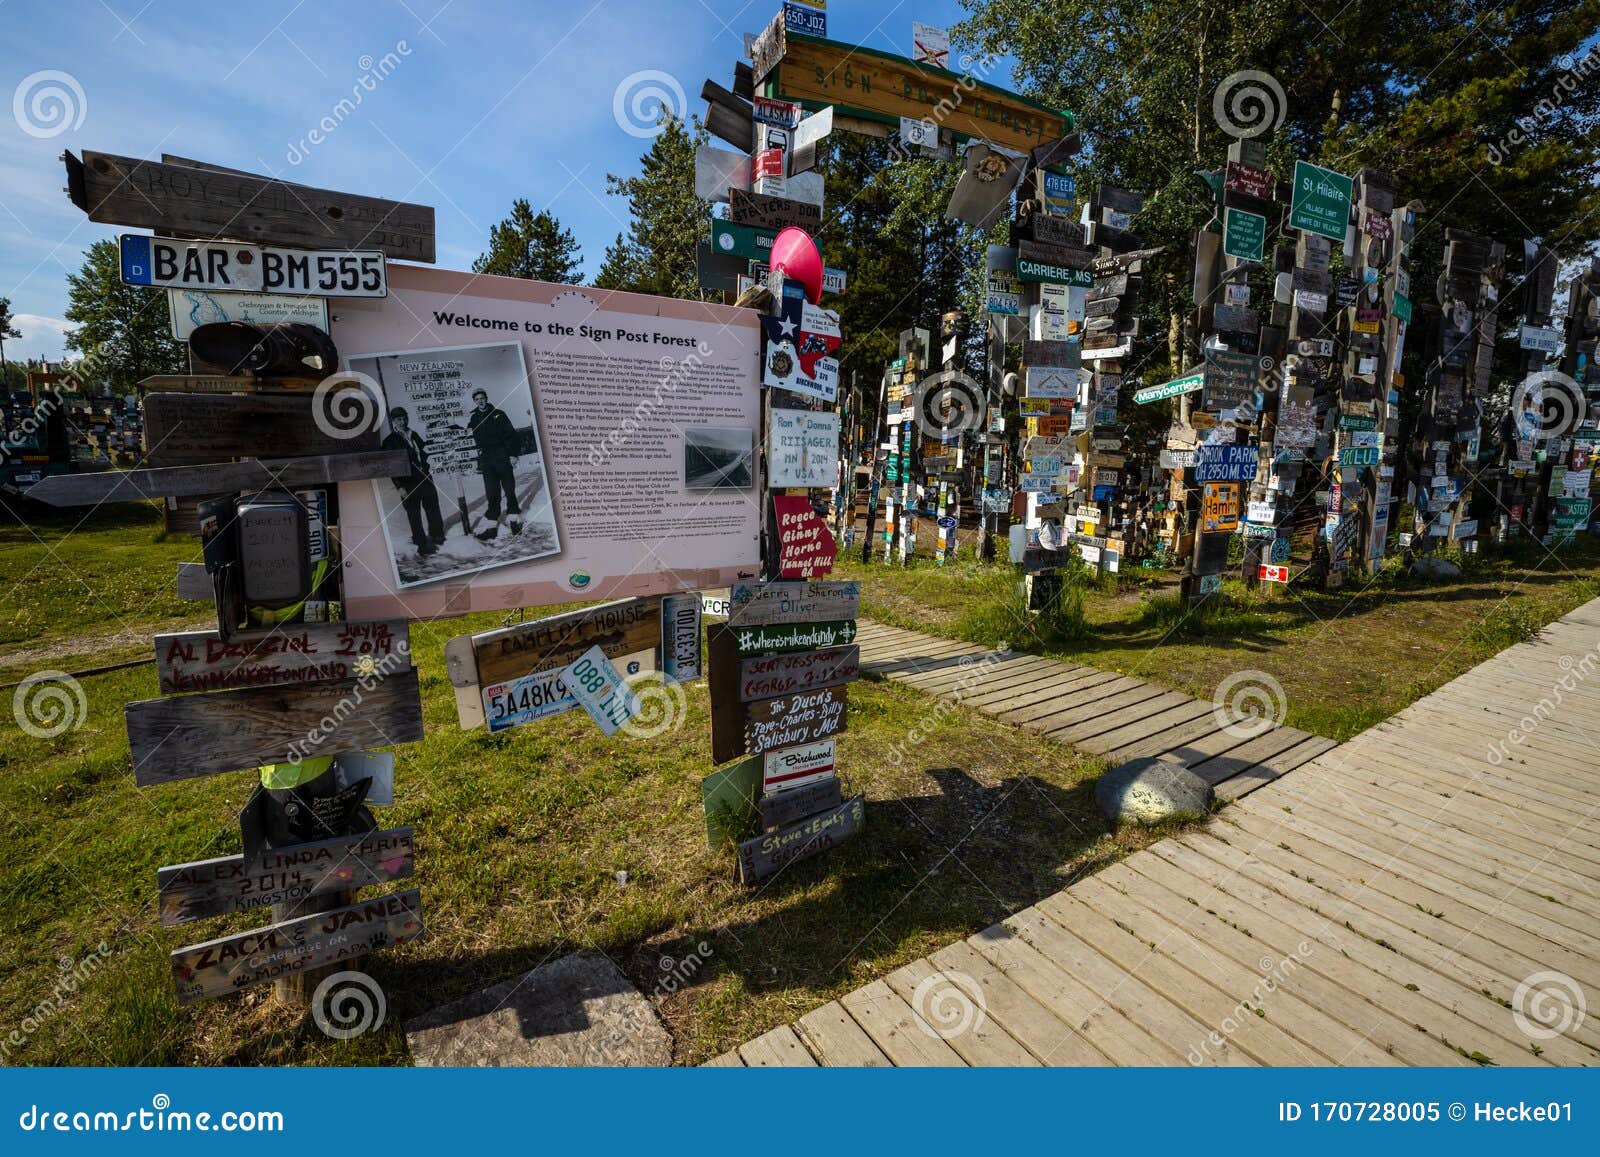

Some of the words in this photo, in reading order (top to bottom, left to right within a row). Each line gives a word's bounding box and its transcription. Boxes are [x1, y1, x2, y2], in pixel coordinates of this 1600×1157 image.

[814, 65, 871, 95] SIGN
[1303, 177, 1313, 191] St
[1316, 183, 1344, 201] Hilaire
[153, 244, 231, 284] BAR
[1019, 260, 1073, 283] CARRIERE,
[1075, 270, 1092, 283] MS
[433, 311, 519, 332] Welcome
[524, 320, 542, 334] to
[548, 323, 574, 336] the
[579, 325, 611, 342] Sign
[616, 329, 649, 343] Post
[653, 332, 697, 348] Forest
[400, 364, 418, 372] NEW
[421, 361, 455, 371] ZEALAND
[1138, 380, 1198, 402] Manyberries
[417, 403, 446, 411] CHICAGO
[778, 417, 793, 428] Ron
[807, 419, 832, 431] Donna
[785, 454, 798, 463] MN
[811, 454, 828, 464] 2014
[1230, 447, 1256, 463] PARK
[795, 468, 814, 479] USA
[782, 510, 815, 526] Reece
[783, 527, 820, 543] Ginny
[786, 541, 822, 557] Horne
[782, 558, 811, 569] Tunnel
[802, 567, 813, 577] GA
[752, 585, 789, 600] Jerry
[807, 584, 842, 598] Sharon
[781, 600, 817, 612] Oliver
[594, 605, 647, 634] HOUSE
[336, 638, 392, 657] 2014
[573, 659, 605, 694] 088
[491, 678, 568, 720] 5A48K9
[789, 689, 832, 714] Duck's
[520, 707, 561, 723] Alabama
[755, 726, 808, 753] Salisbury
[780, 747, 832, 766] Birchwood
[761, 830, 802, 855] Steve
[262, 848, 333, 870] LINDA
[240, 871, 301, 894] 2014
[235, 883, 315, 910] KINGSTON
[195, 931, 277, 971] ZACH
